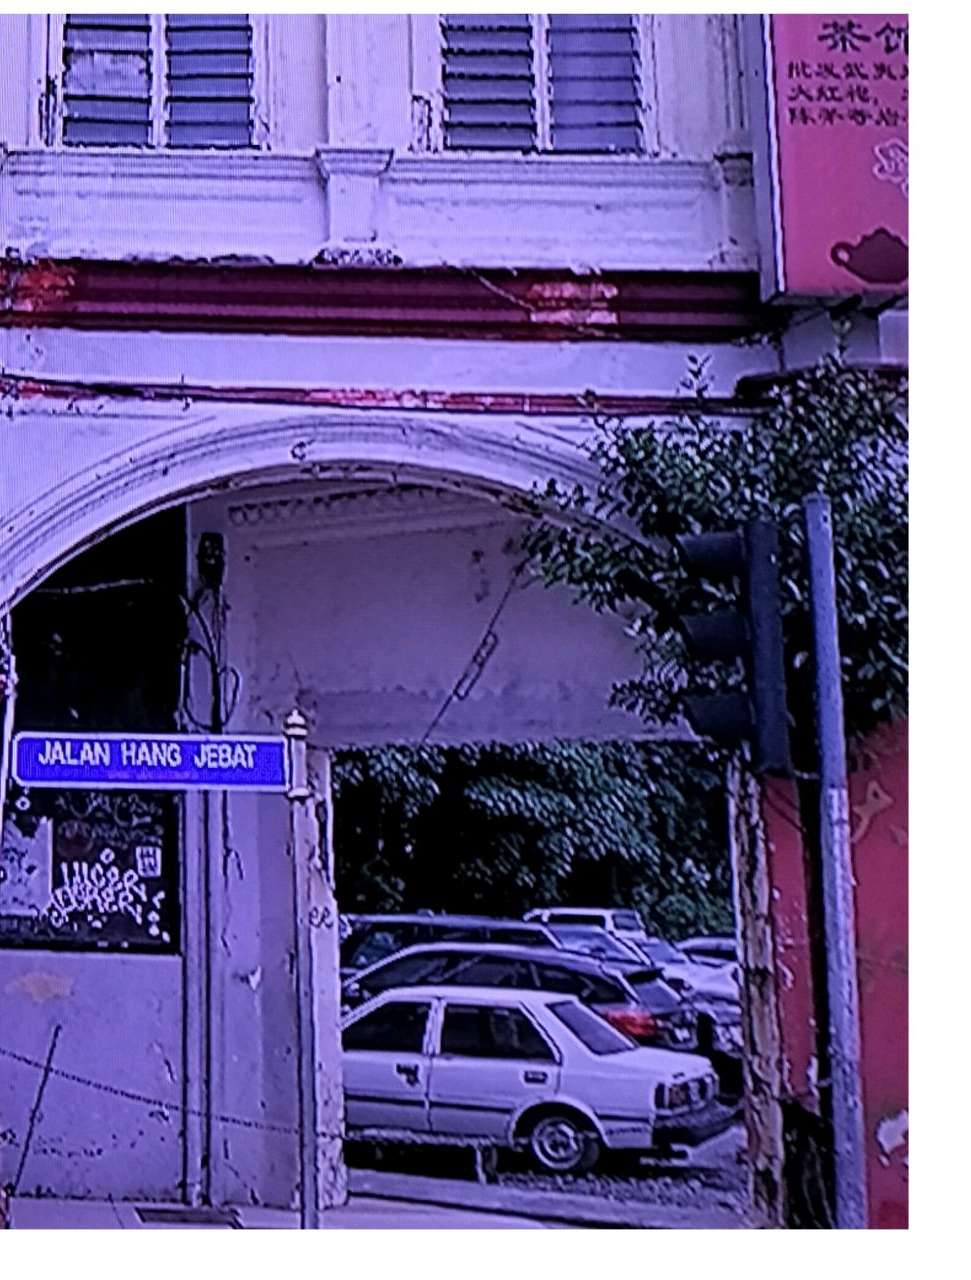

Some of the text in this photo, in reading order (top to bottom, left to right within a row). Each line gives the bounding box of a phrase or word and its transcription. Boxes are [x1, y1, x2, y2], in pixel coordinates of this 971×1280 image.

[38, 741, 257, 769] JALAN HANG JEBAT
